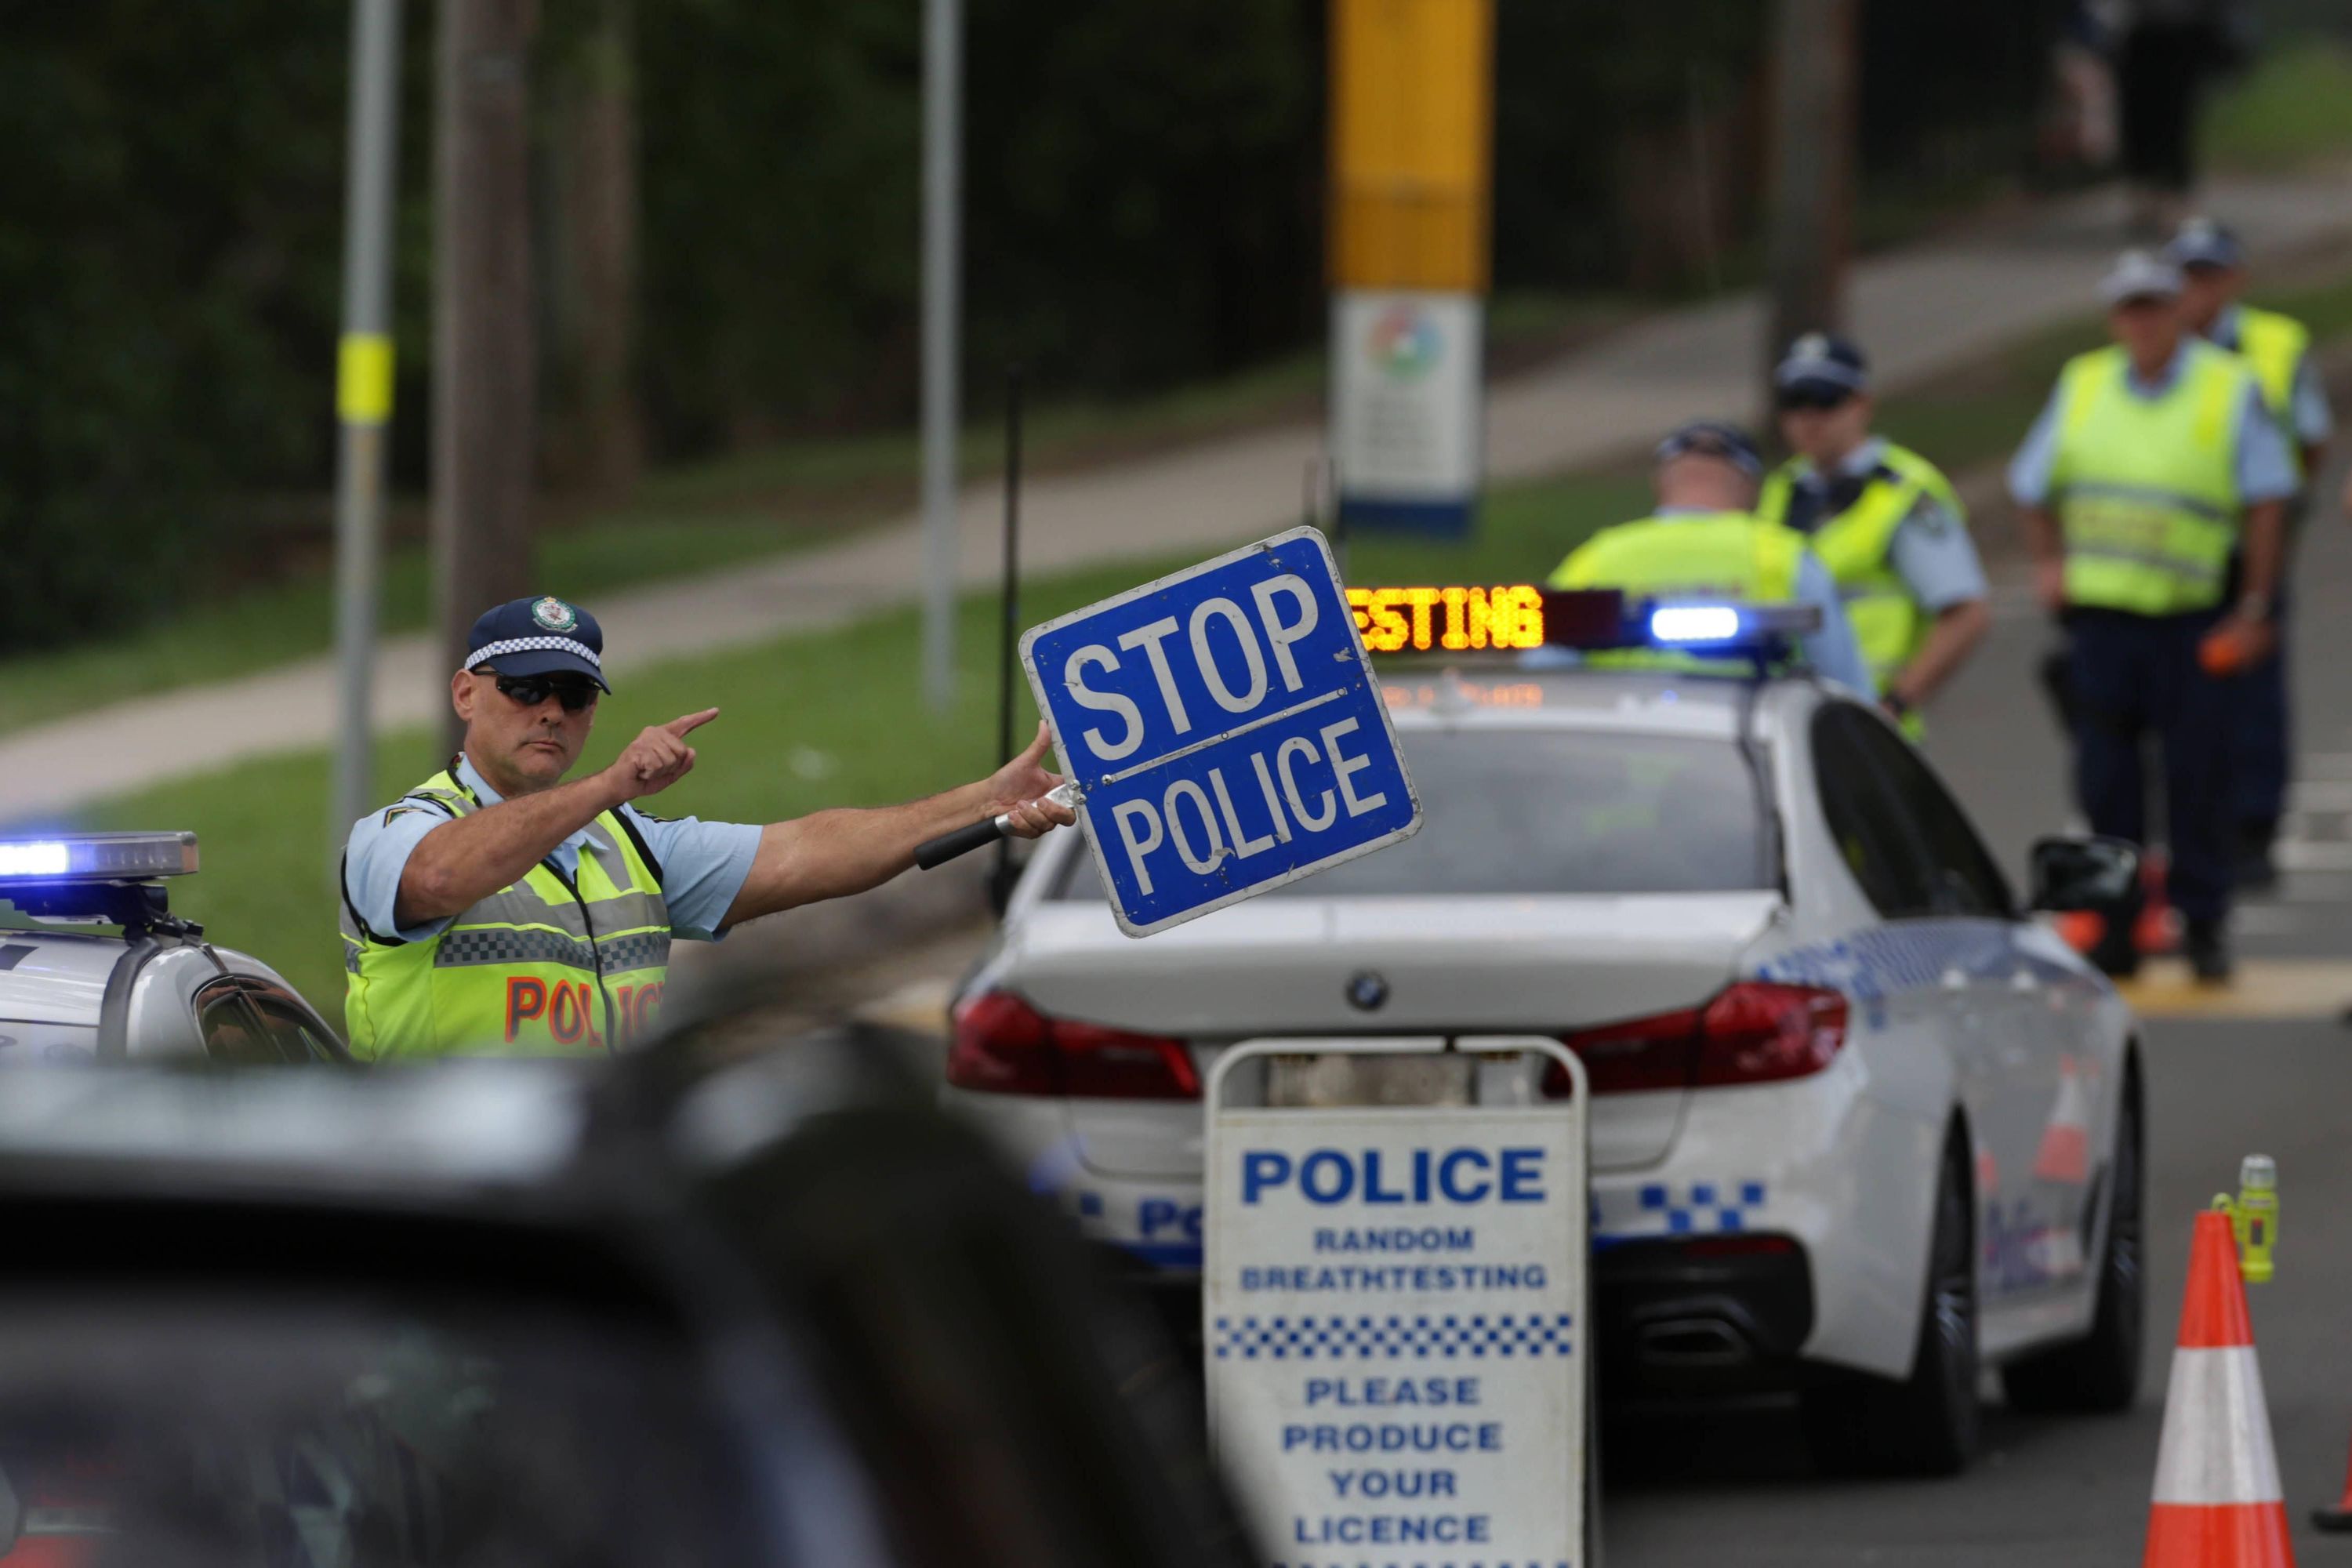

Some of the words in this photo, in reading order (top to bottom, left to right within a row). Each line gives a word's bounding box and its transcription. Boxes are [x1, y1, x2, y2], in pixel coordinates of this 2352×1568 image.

[1063, 574, 1319, 761] STOP
[1112, 717, 1388, 895] POLICE
[1242, 1147, 1546, 1206] POLICE
[1315, 1228, 1474, 1253] RANDOM
[1241, 1265, 1547, 1290] BREATHTESTING
[1306, 1377, 1480, 1406] PLEASE
[1282, 1423, 1503, 1452] PRODUCE
[1330, 1470, 1457, 1497] YOUR
[1295, 1515, 1490, 1544] LICENCE
